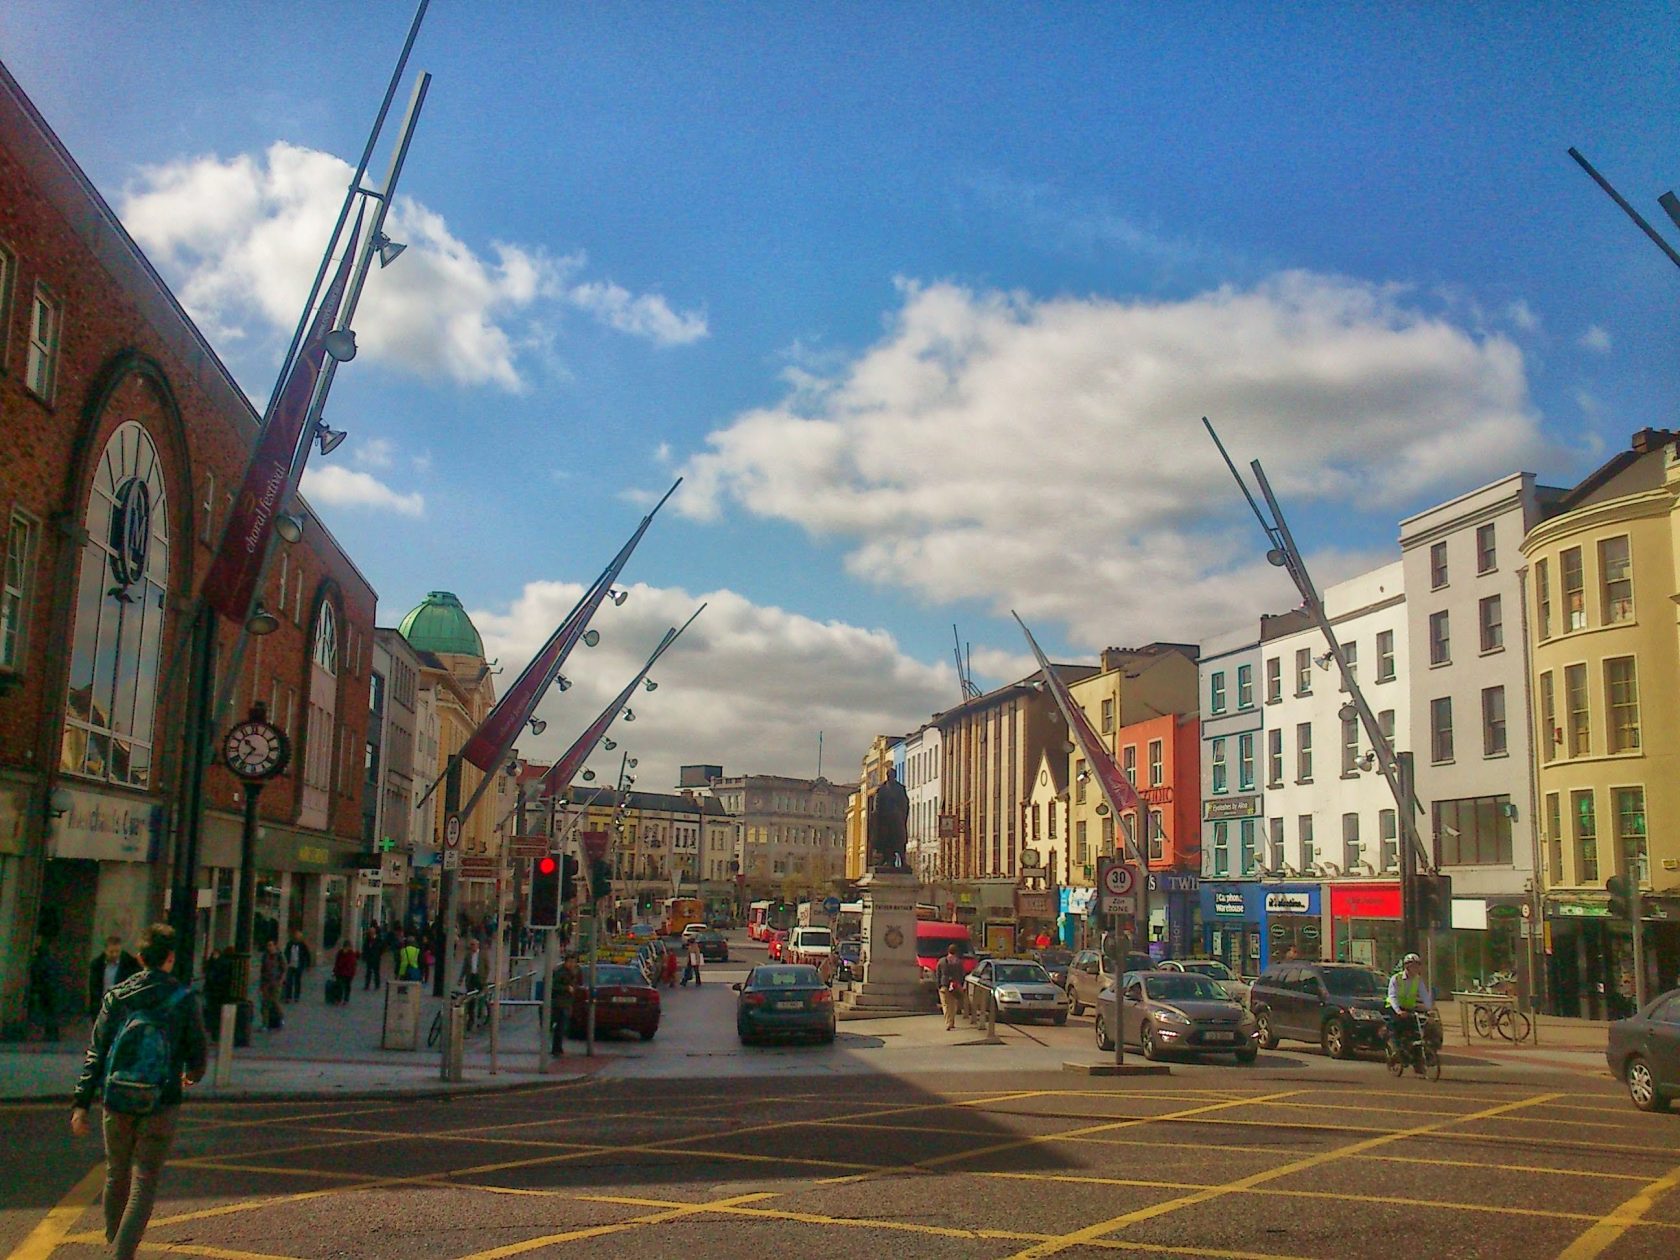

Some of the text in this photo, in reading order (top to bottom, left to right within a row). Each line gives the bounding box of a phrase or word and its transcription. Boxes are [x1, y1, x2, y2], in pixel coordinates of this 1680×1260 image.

[245, 461, 286, 554] choral festival
[1112, 871, 1126, 883] 30
[1215, 903, 1244, 912] Warehouse
